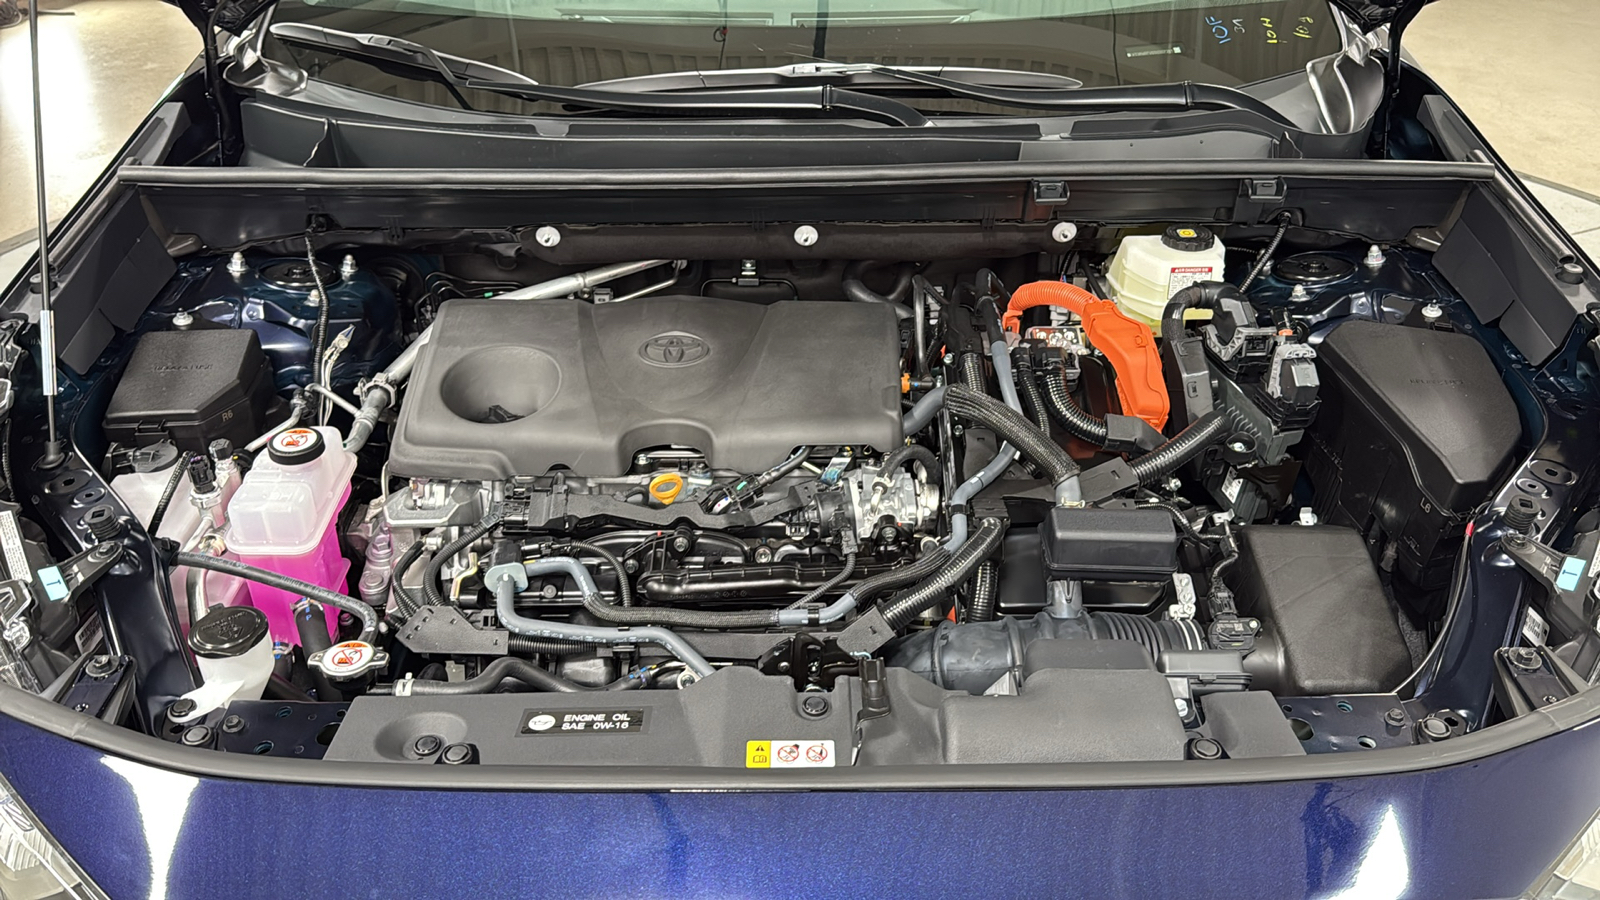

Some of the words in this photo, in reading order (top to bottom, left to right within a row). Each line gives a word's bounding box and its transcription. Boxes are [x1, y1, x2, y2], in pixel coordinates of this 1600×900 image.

[563, 714, 606, 722] ENGINE
[612, 713, 631, 721] OIL
[561, 722, 585, 730] SAE
